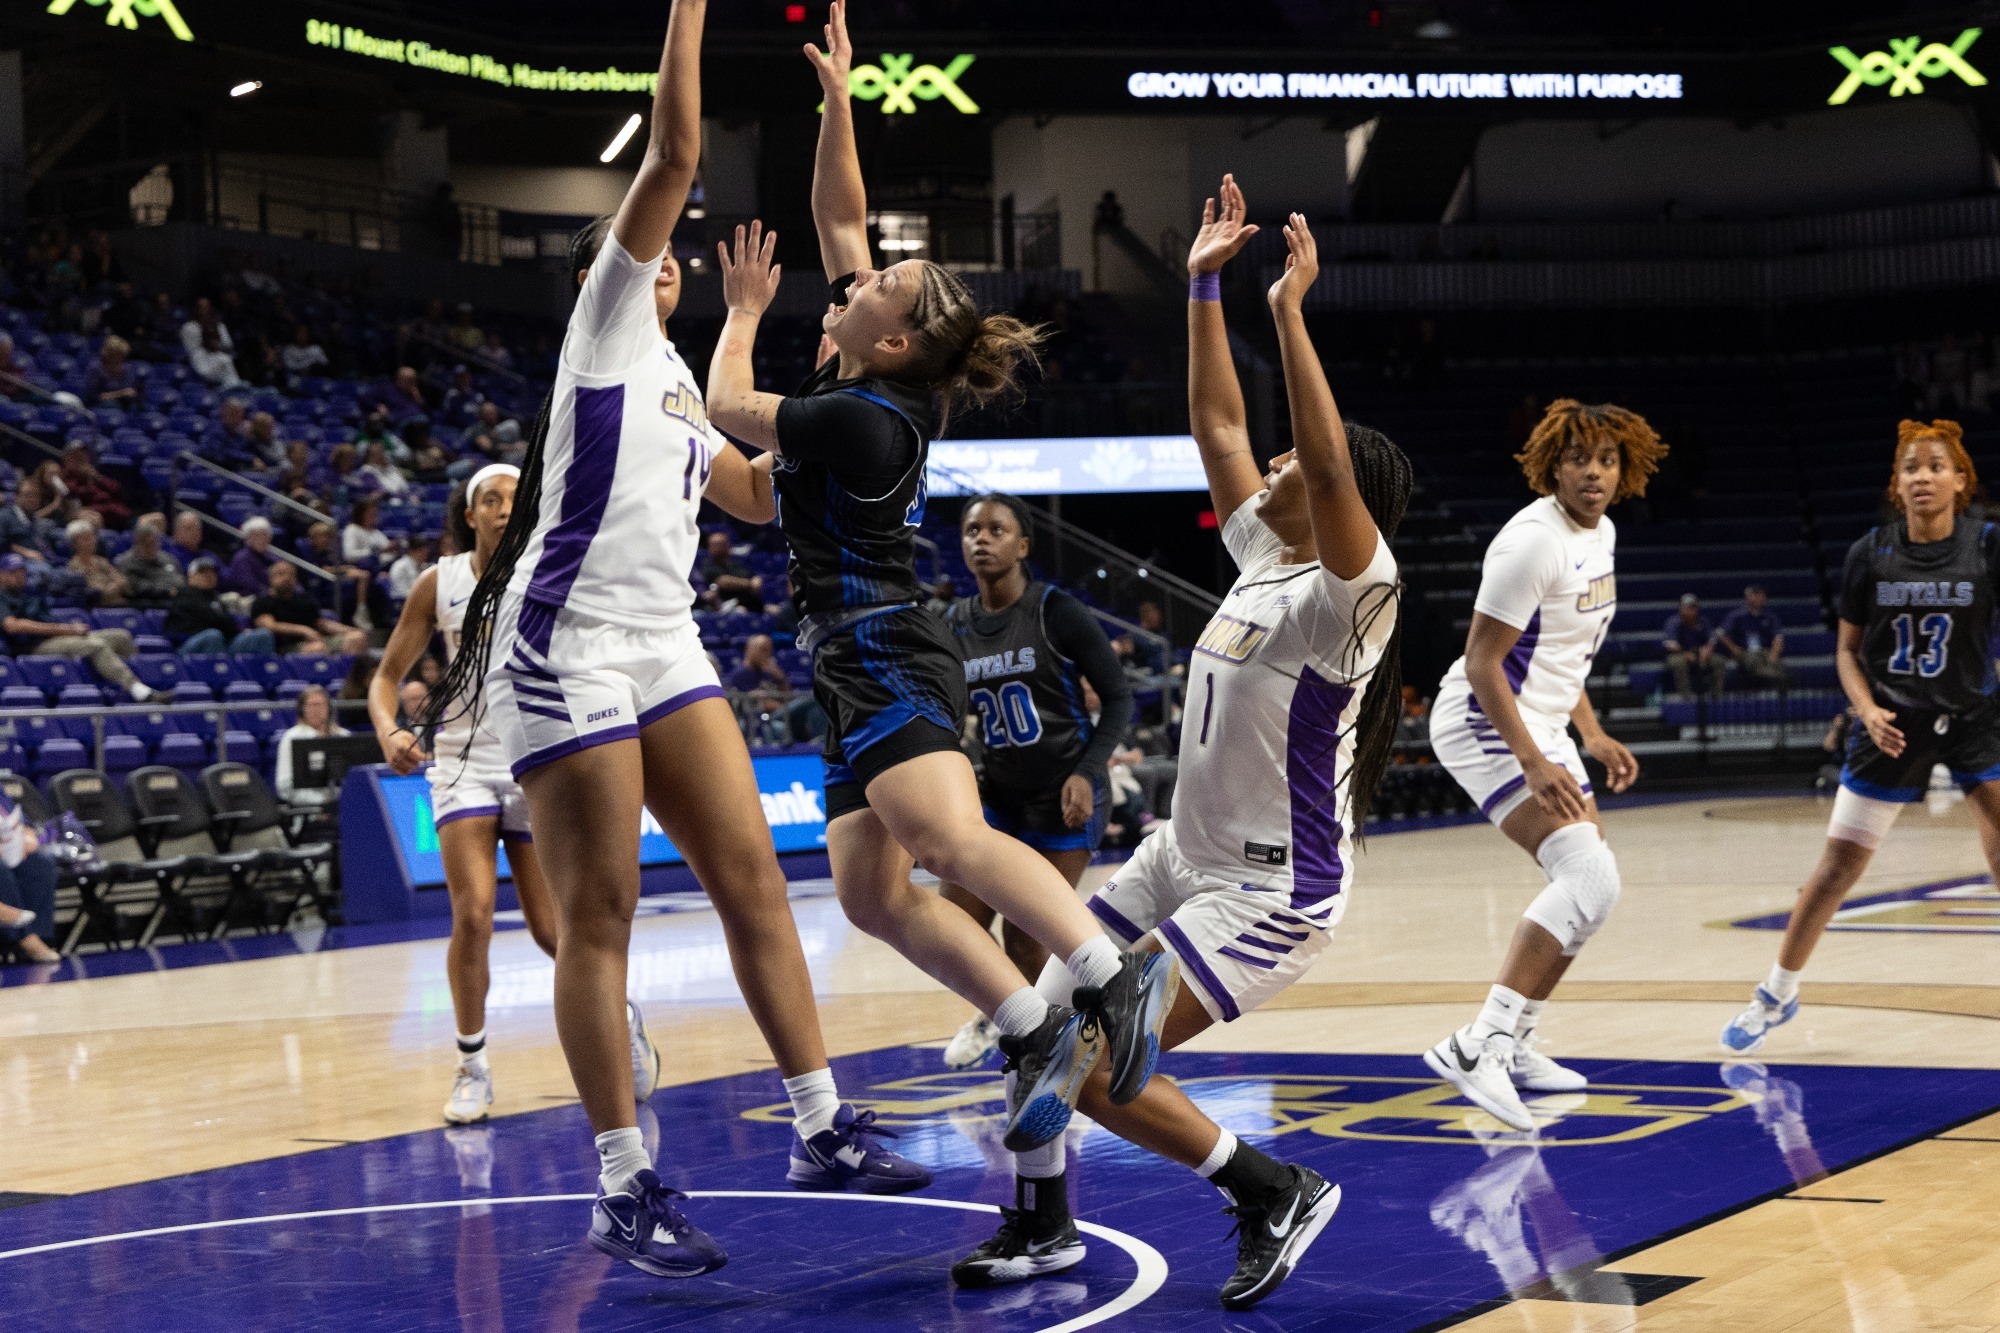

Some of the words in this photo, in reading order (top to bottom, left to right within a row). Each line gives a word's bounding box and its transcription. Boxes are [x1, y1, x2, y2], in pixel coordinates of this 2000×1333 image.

[306, 19, 341, 48] 841
[343, 26, 405, 63] Mount
[406, 40, 469, 76] Clinton
[470, 54, 512, 87] Pike,
[1128, 72, 1210, 98] GROW
[1211, 73, 1286, 98] YOUR
[1287, 73, 1415, 98] FINANCIAL
[1416, 73, 1508, 98] FUTURE
[1509, 73, 1575, 98] WITH
[1577, 73, 1683, 98] PURPOSE
[661, 380, 709, 440] JM
[1576, 572, 1616, 613] JM
[1876, 581, 1975, 607] ROYALS
[963, 646, 1037, 683] OYALS
[1887, 613, 1954, 678] 13
[587, 706, 619, 723] DUKES
[970, 680, 1044, 749] 20
[1200, 672, 1214, 746] 1
[758, 781, 827, 827] ank
[1272, 850, 1281, 860] M
